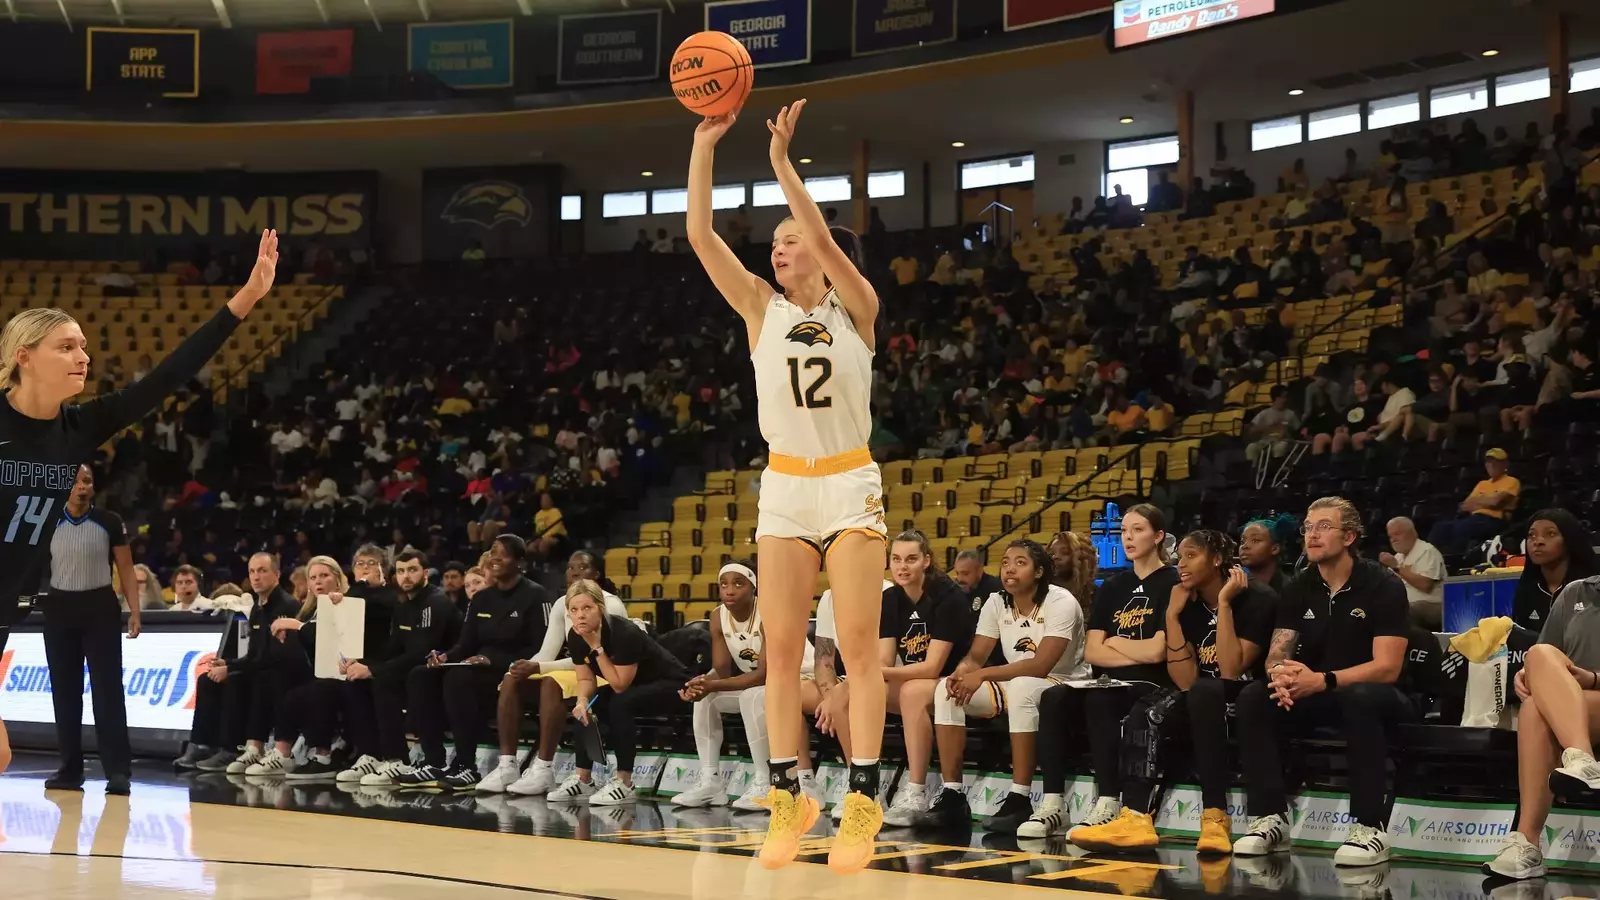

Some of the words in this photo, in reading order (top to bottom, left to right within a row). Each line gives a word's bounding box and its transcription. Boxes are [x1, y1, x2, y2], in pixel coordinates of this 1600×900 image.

[730, 15, 786, 34] GEORGIA
[1147, 15, 1194, 38] Dandy
[1196, 4, 1239, 27] Dan's
[129, 47, 158, 61] APP
[120, 64, 166, 79] STATE
[220, 193, 365, 236] MISS
[787, 357, 832, 408] 12
[0, 460, 77, 490] OPPERS
[4, 496, 55, 545] 14
[1113, 606, 1153, 622] Southern
[1120, 616, 1145, 629] Miss
[1424, 821, 1508, 836] AIRSOUTH
[1421, 834, 1454, 842] COOLING
